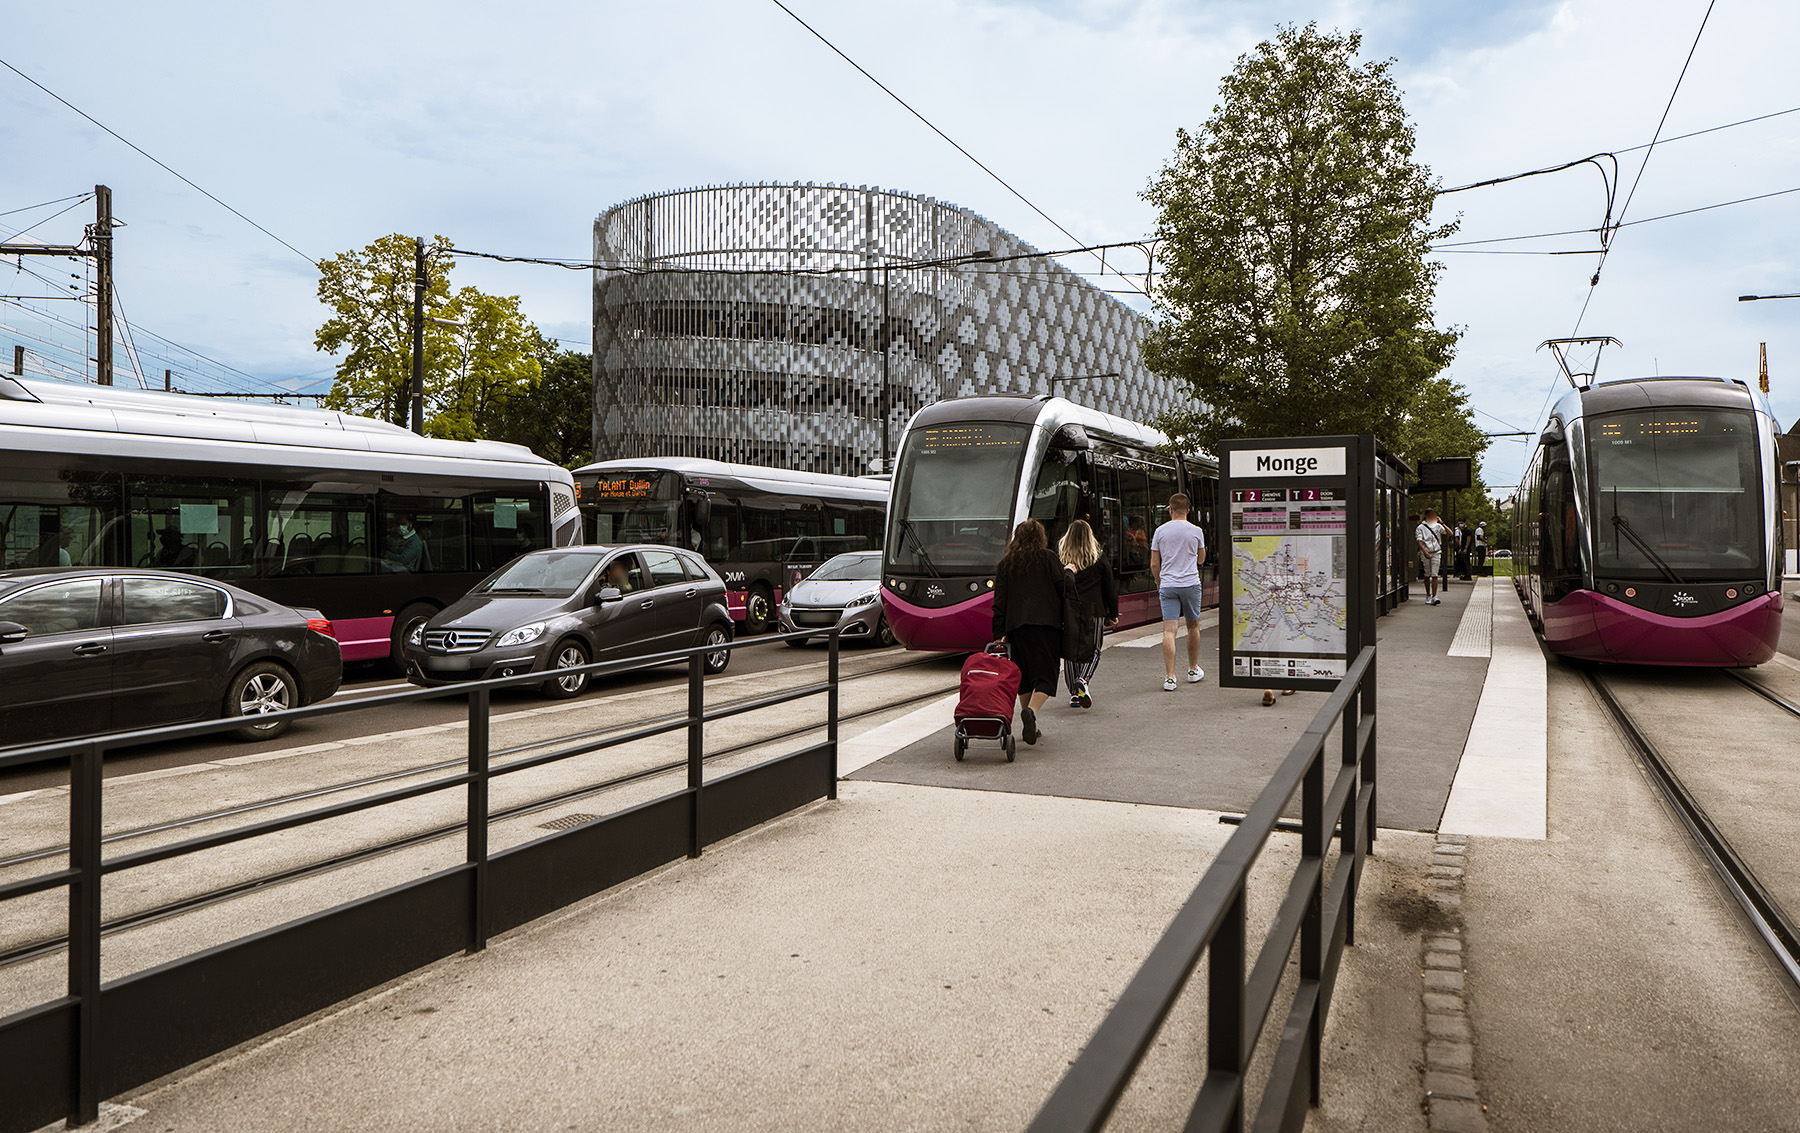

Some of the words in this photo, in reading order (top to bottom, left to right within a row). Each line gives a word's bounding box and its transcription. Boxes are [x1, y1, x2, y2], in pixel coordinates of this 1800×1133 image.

[1257, 455, 1318, 475] Monge
[598, 480, 627, 491] TALANT
[1236, 492, 1242, 501] T
[1249, 491, 1256, 501] 2
[1293, 490, 1300, 500] T
[1308, 490, 1314, 500] 2
